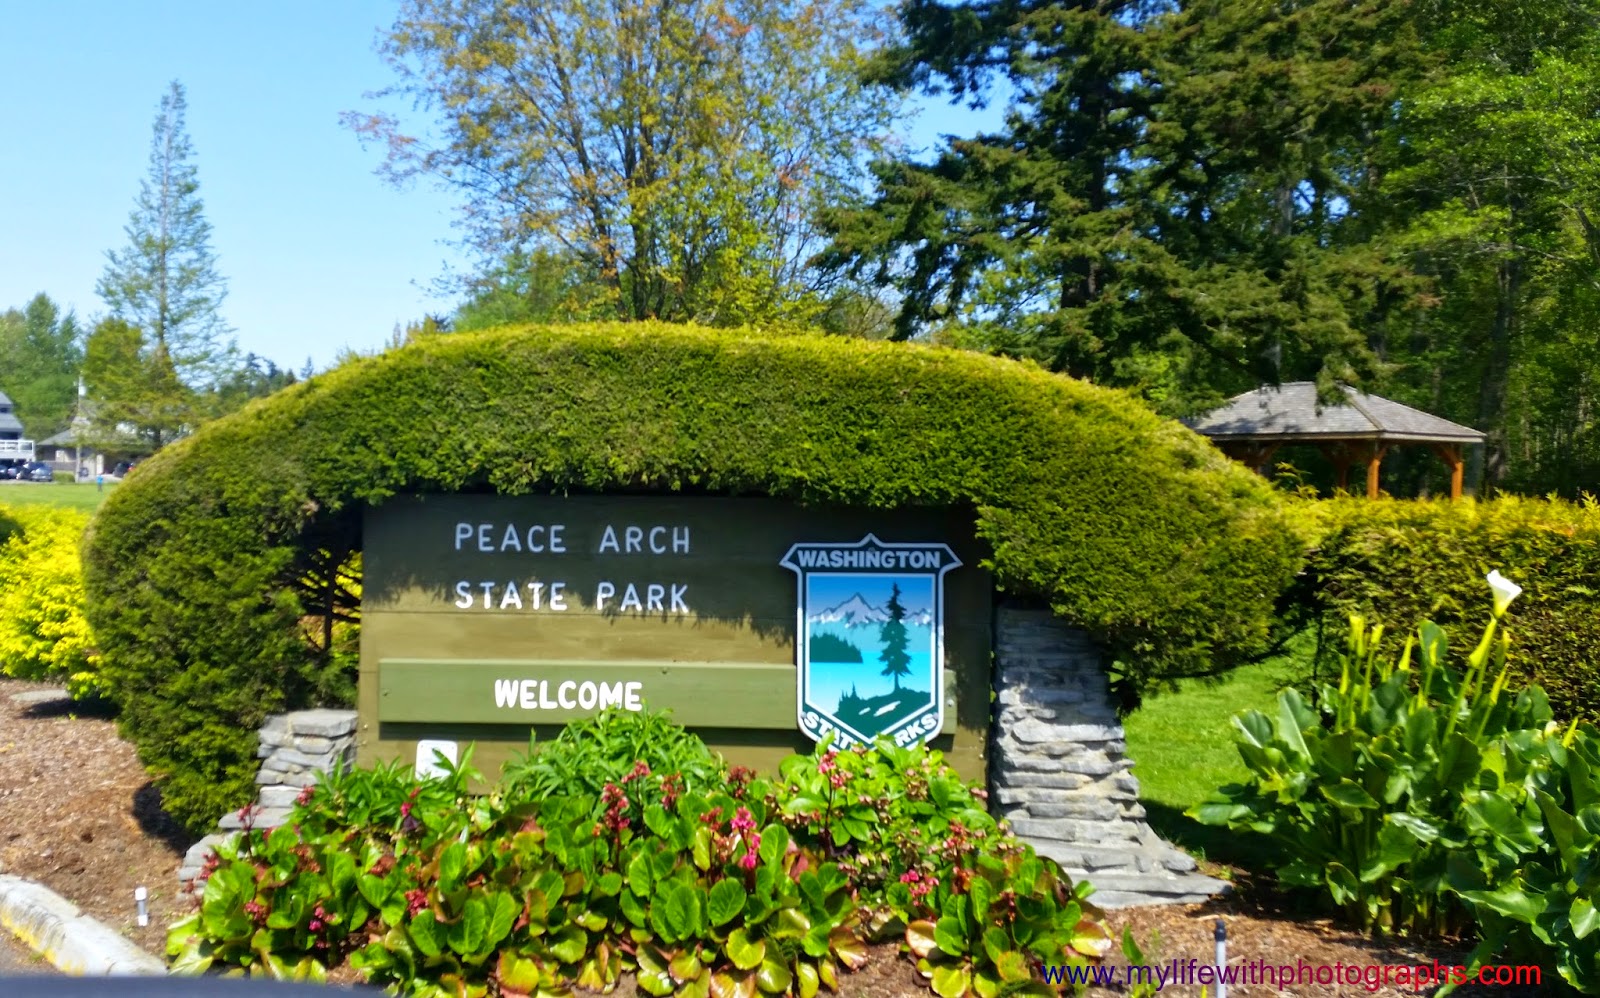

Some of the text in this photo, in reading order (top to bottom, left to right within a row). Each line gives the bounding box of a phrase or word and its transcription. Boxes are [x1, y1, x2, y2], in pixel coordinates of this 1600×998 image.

[455, 523, 690, 553] PEACE ARCH
[797, 550, 941, 569] WASHINGTON
[455, 581, 689, 612] STATE PARK
[494, 679, 643, 711] WELCOME
[803, 711, 937, 750] STAT RKS
